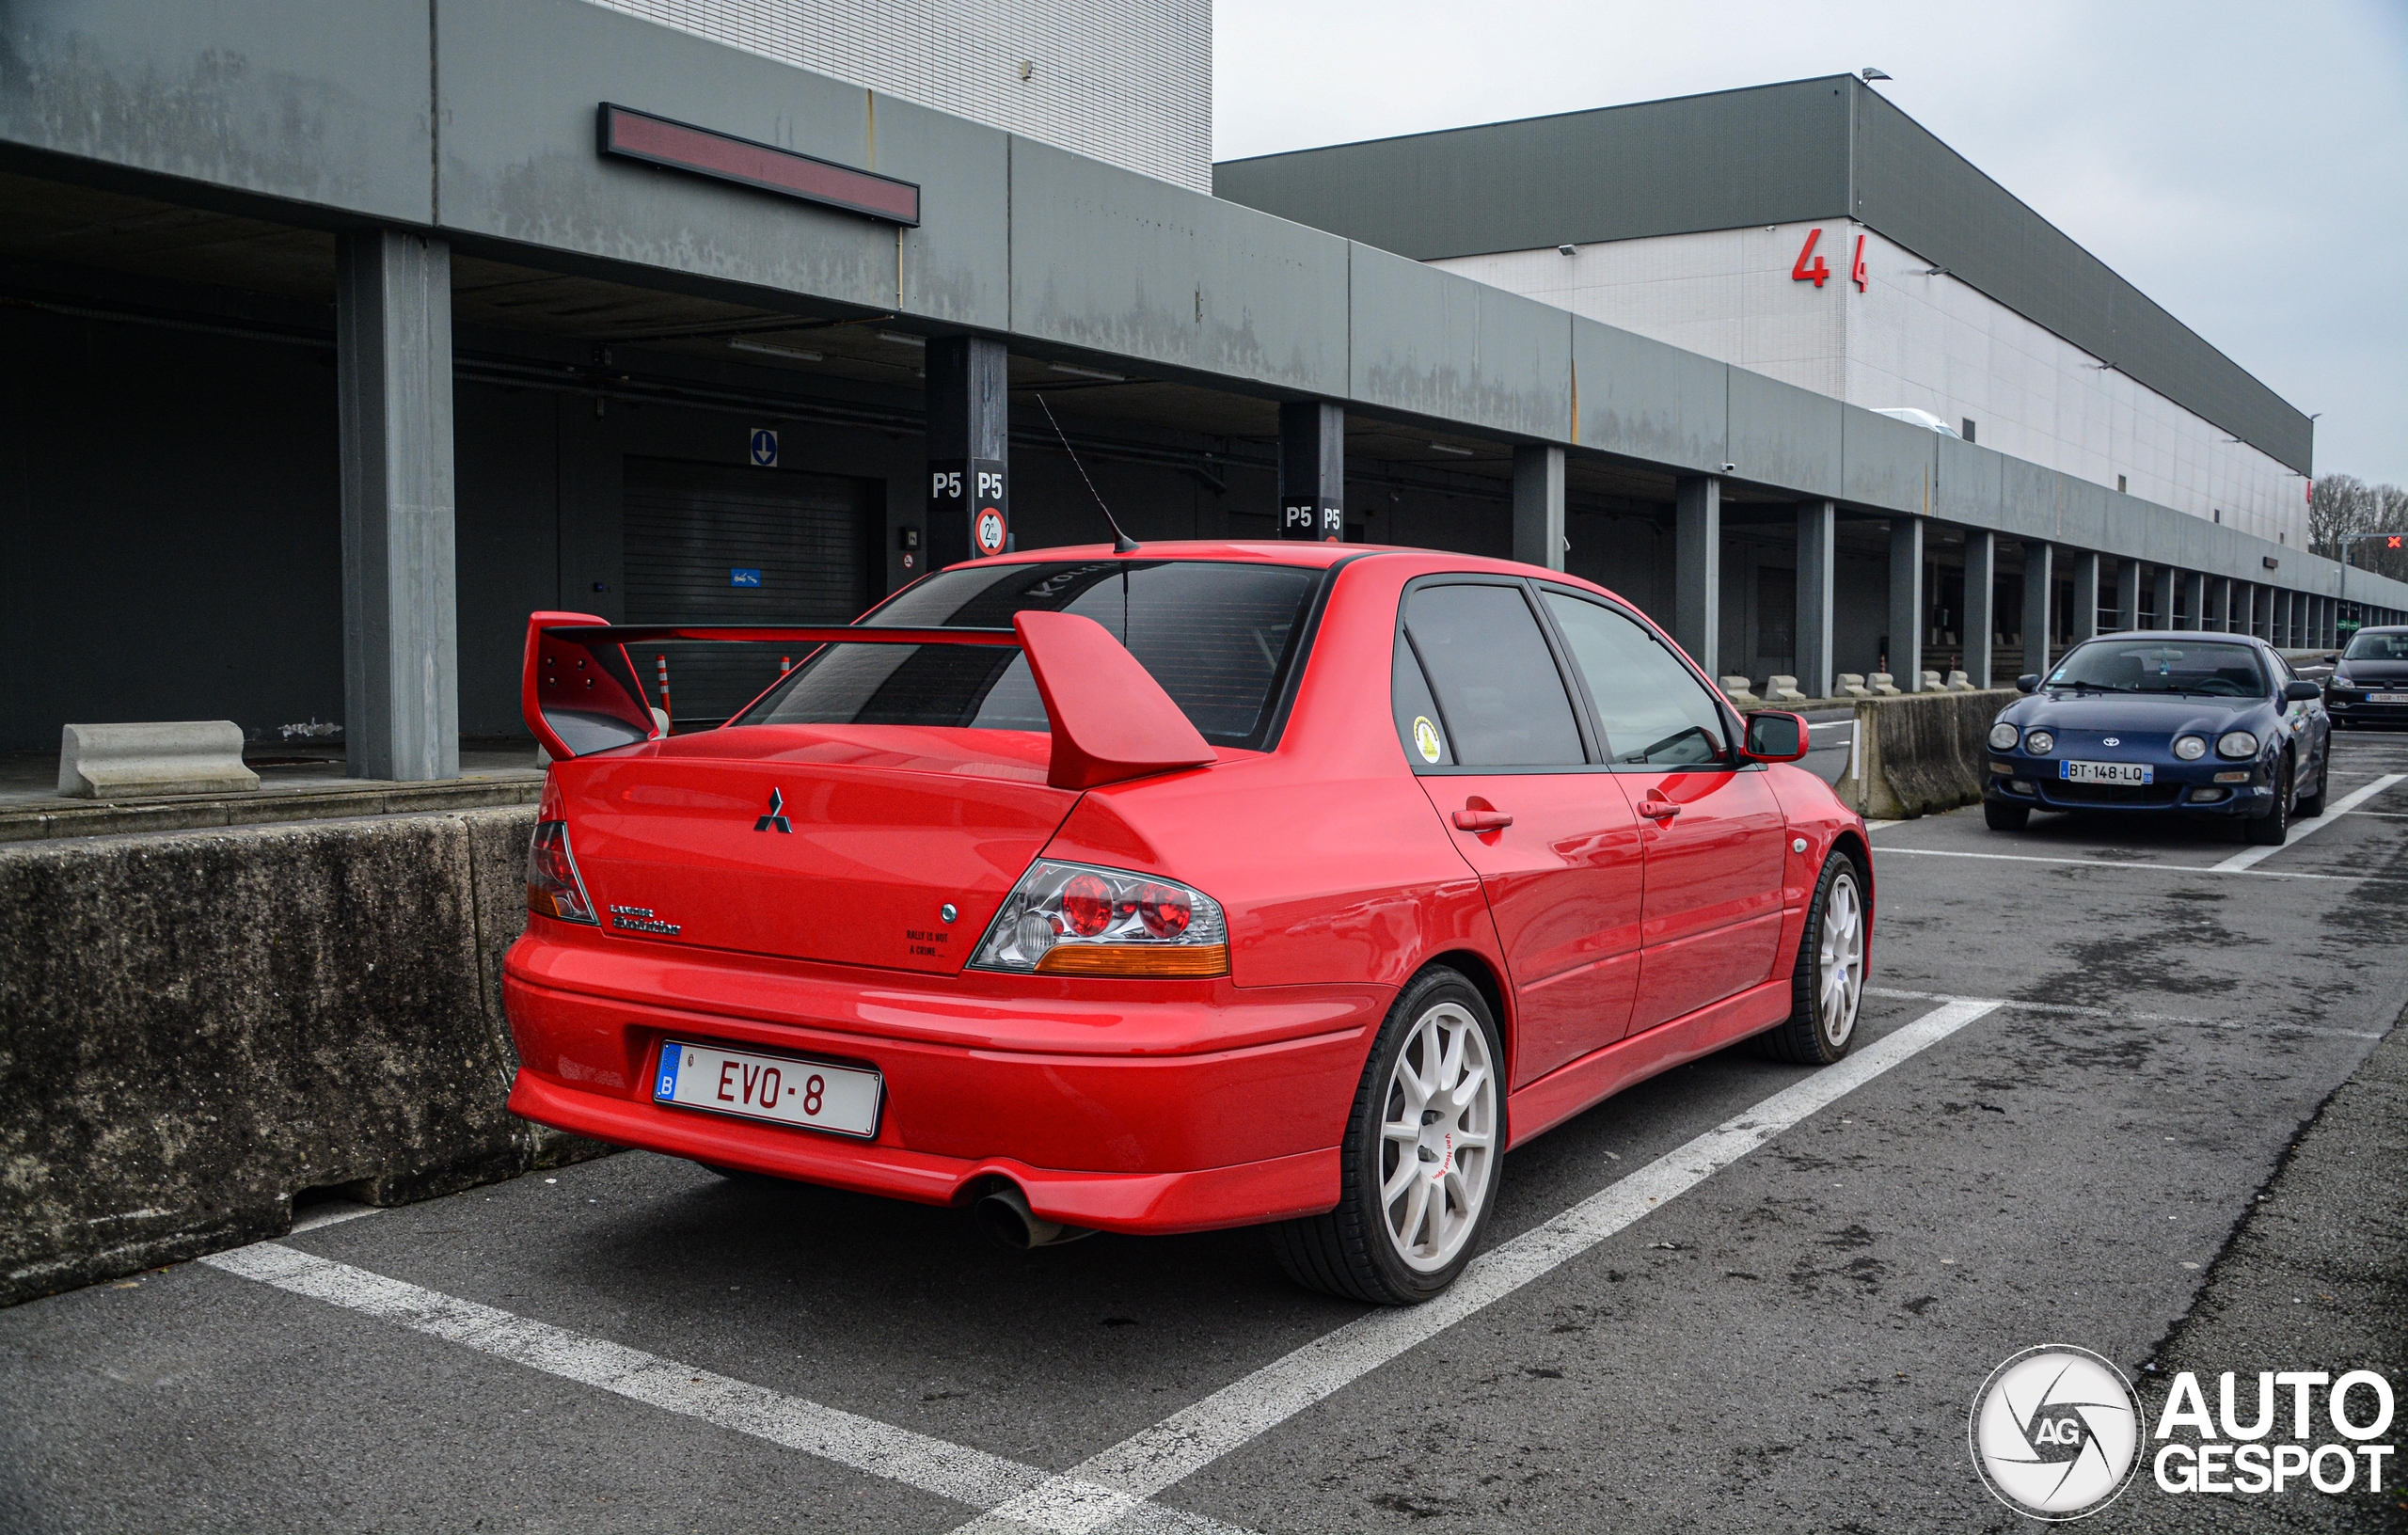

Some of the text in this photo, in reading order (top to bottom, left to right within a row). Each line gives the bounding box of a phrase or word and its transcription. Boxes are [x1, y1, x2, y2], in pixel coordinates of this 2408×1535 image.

[1792, 229, 1830, 288] 4
[1852, 234, 1869, 293] 4
[933, 472, 961, 498] P5
[978, 472, 1003, 499] P5
[1286, 506, 1312, 528] P5
[1323, 508, 1340, 530] P5
[2069, 763, 2143, 782] BT-148-LQ
[610, 904, 654, 918] LANCER
[613, 916, 681, 936] Evolution
[906, 930, 948, 943] RALLY IS NOT
[910, 945, 915, 955] A
[661, 1076, 673, 1096] B
[717, 1060, 825, 1116] EVO-8
[1444, 1151, 1453, 1170] Hoof
